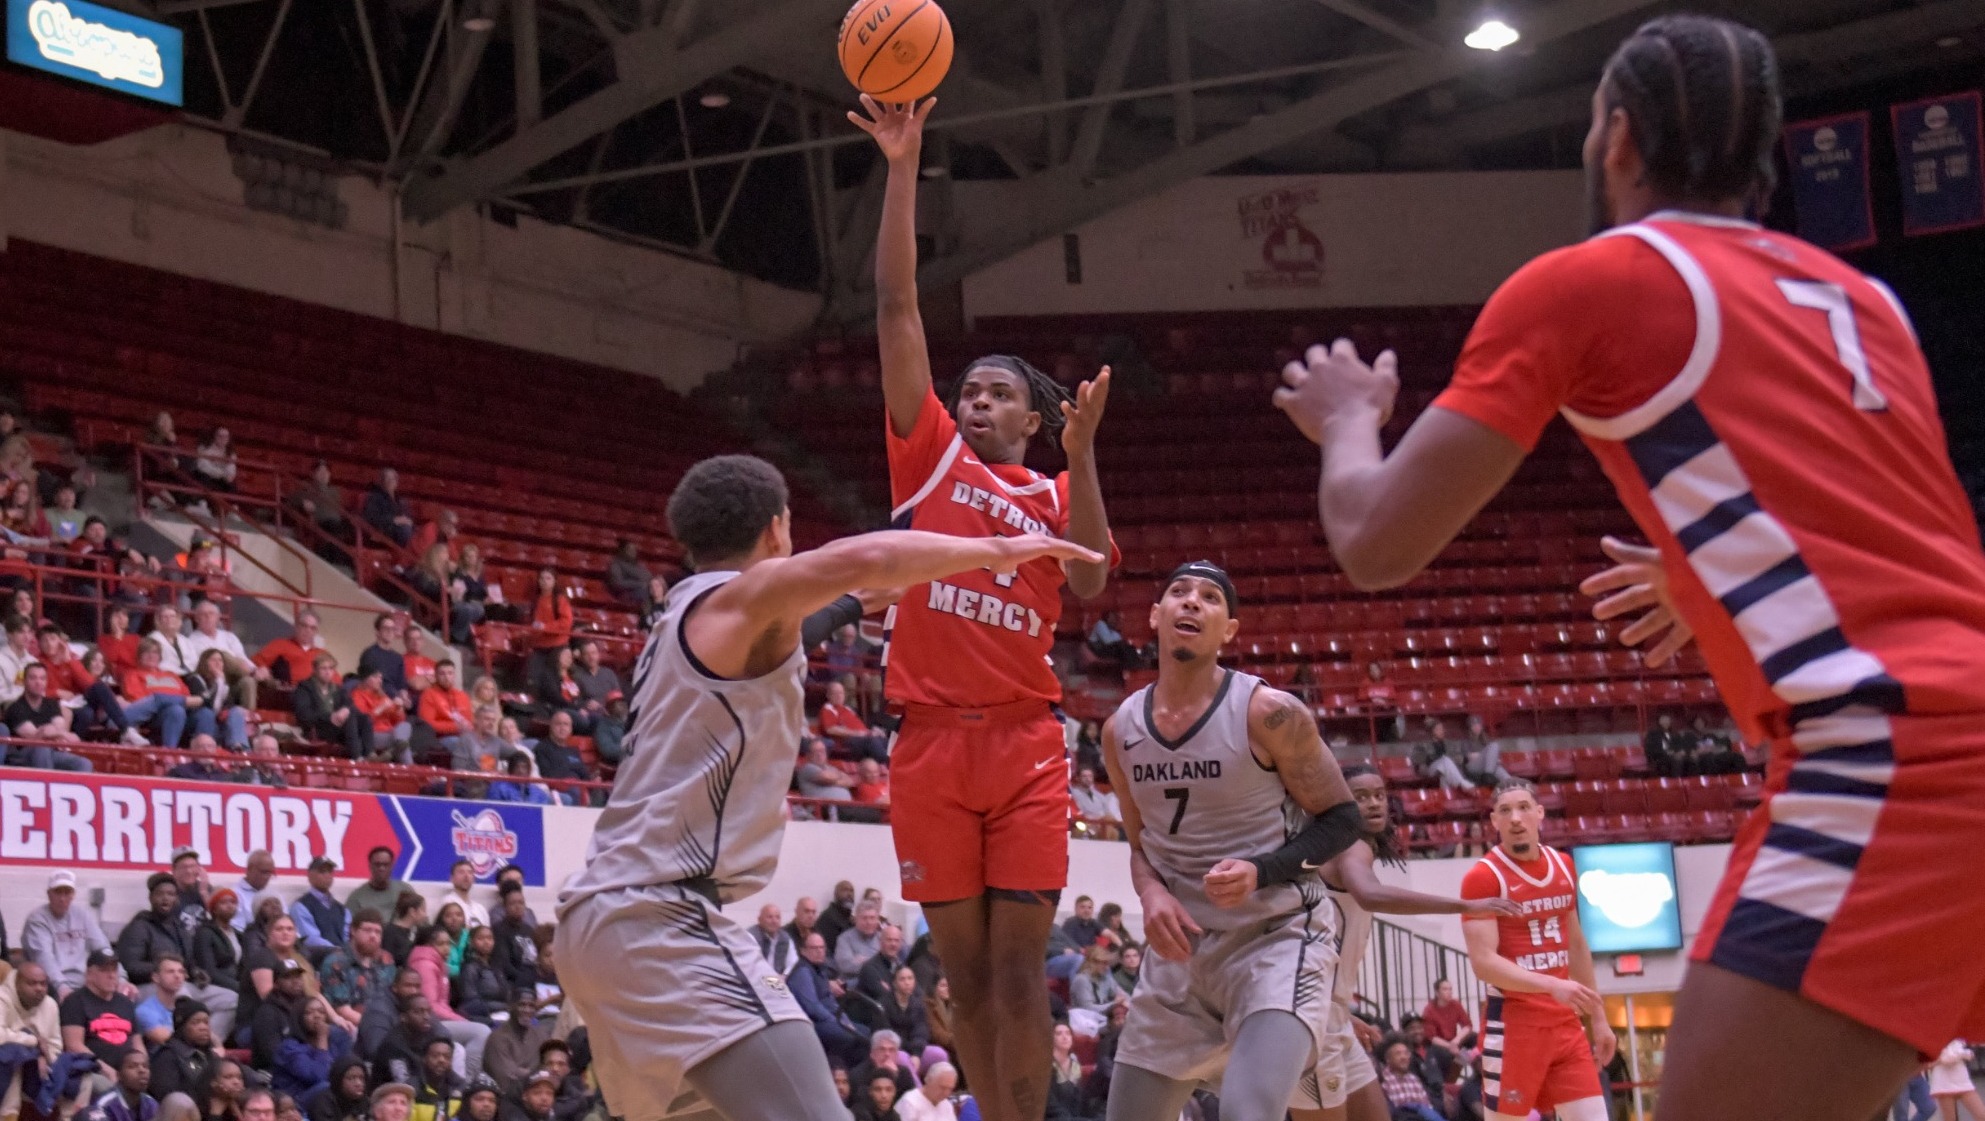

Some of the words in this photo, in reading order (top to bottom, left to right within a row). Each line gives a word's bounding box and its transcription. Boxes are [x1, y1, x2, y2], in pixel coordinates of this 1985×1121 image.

[1773, 278, 1888, 412] 7
[927, 580, 1042, 638] MERCY
[1133, 760, 1222, 783] OAKLAND
[0, 779, 353, 872] ERRITORY
[1164, 787, 1190, 835] 7
[456, 831, 514, 854] TITANS
[1521, 894, 1573, 915] ETROIT
[1528, 916, 1562, 947] 14
[1515, 949, 1569, 971] MERC
